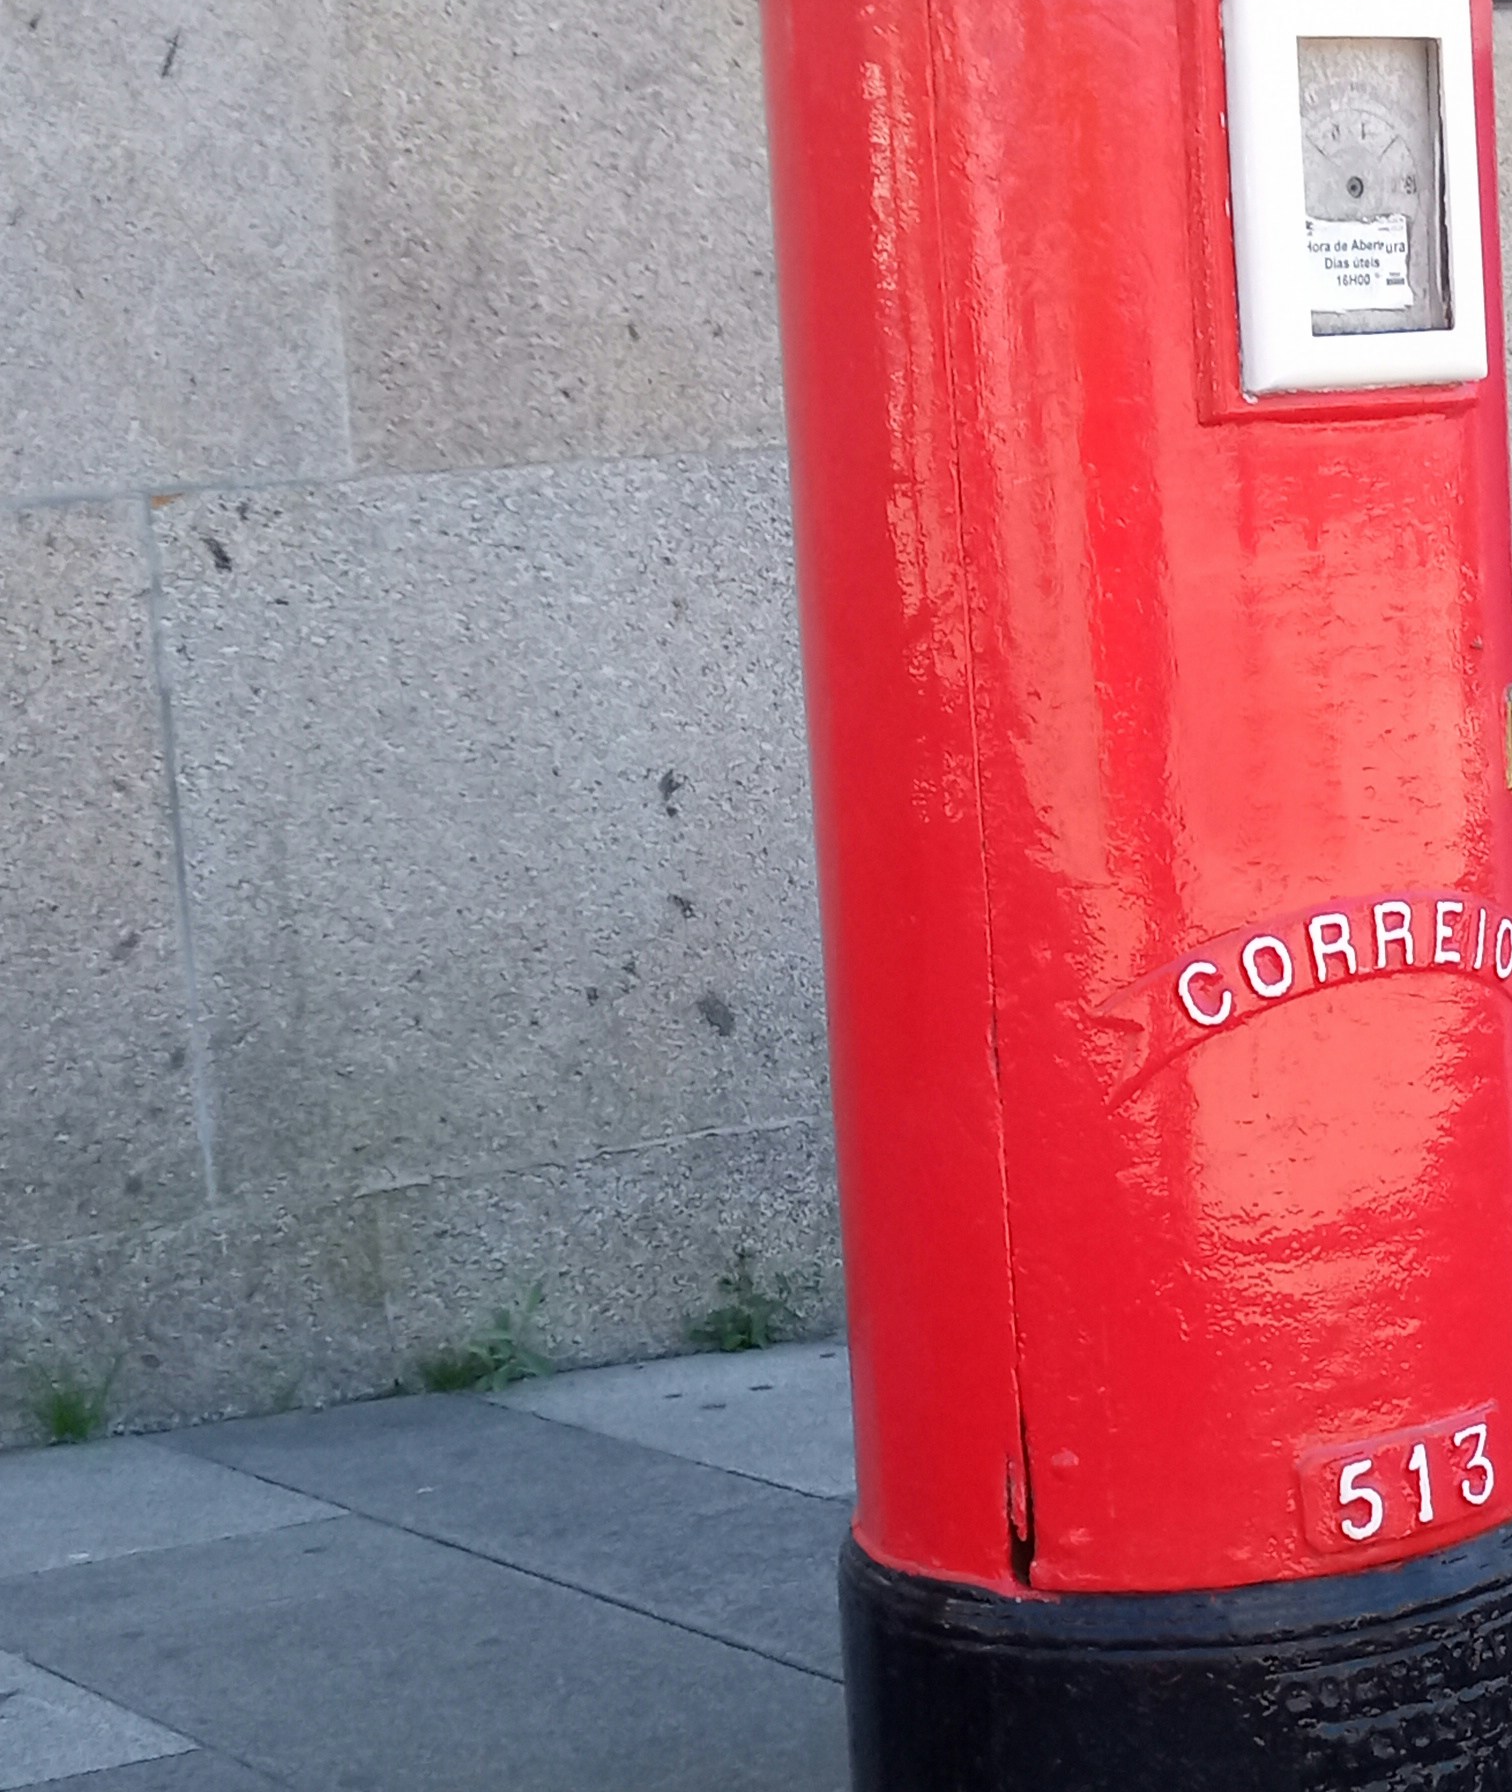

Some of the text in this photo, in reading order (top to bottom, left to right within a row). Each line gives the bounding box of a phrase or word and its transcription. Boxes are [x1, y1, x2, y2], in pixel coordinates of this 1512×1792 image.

[1334, 240, 1348, 252] de
[1324, 256, 1381, 269] Dias úteis
[1339, 1423, 1495, 1541] 513
